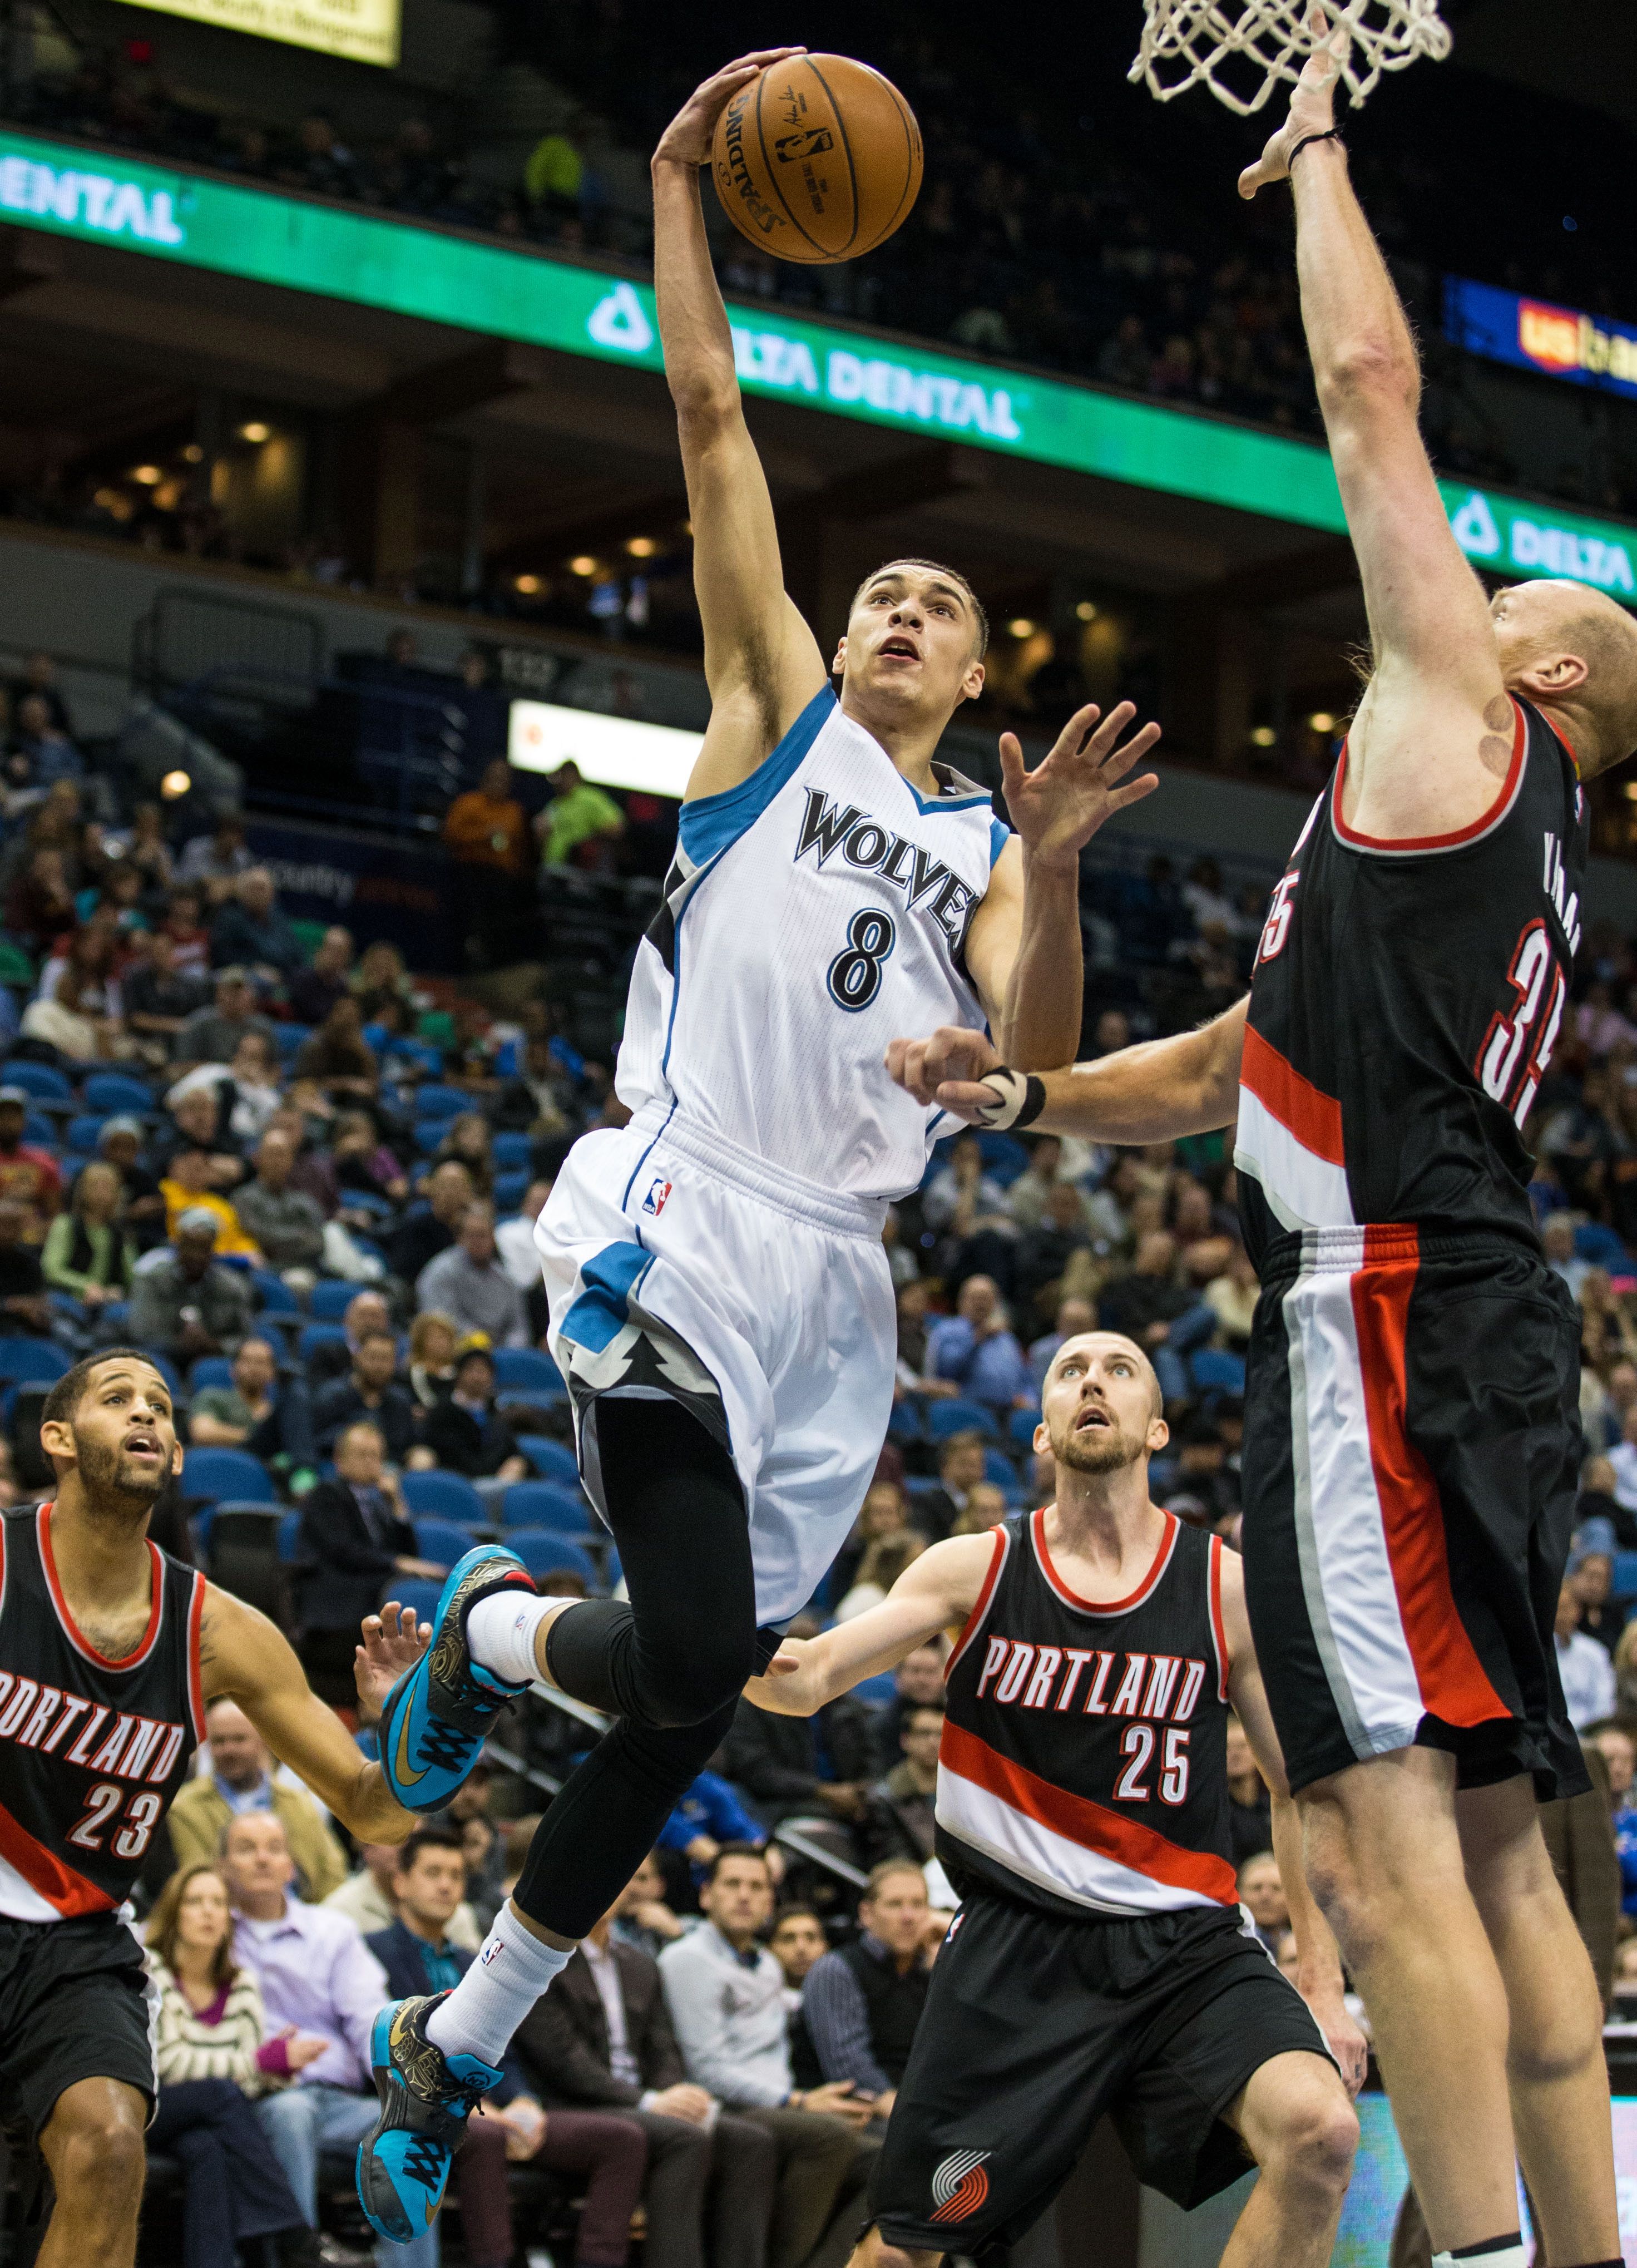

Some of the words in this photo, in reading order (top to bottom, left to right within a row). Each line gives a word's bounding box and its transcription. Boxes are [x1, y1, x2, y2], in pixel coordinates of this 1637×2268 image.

[726, 93, 787, 234] SPALDING
[827, 350, 1021, 441] DENTAL
[1509, 519, 1634, 592] DELTA
[826, 907, 896, 1013] 8
[976, 1635, 1206, 1722] PORTLAND
[1112, 1722, 1190, 1806] 25
[66, 1782, 162, 1859] 23
